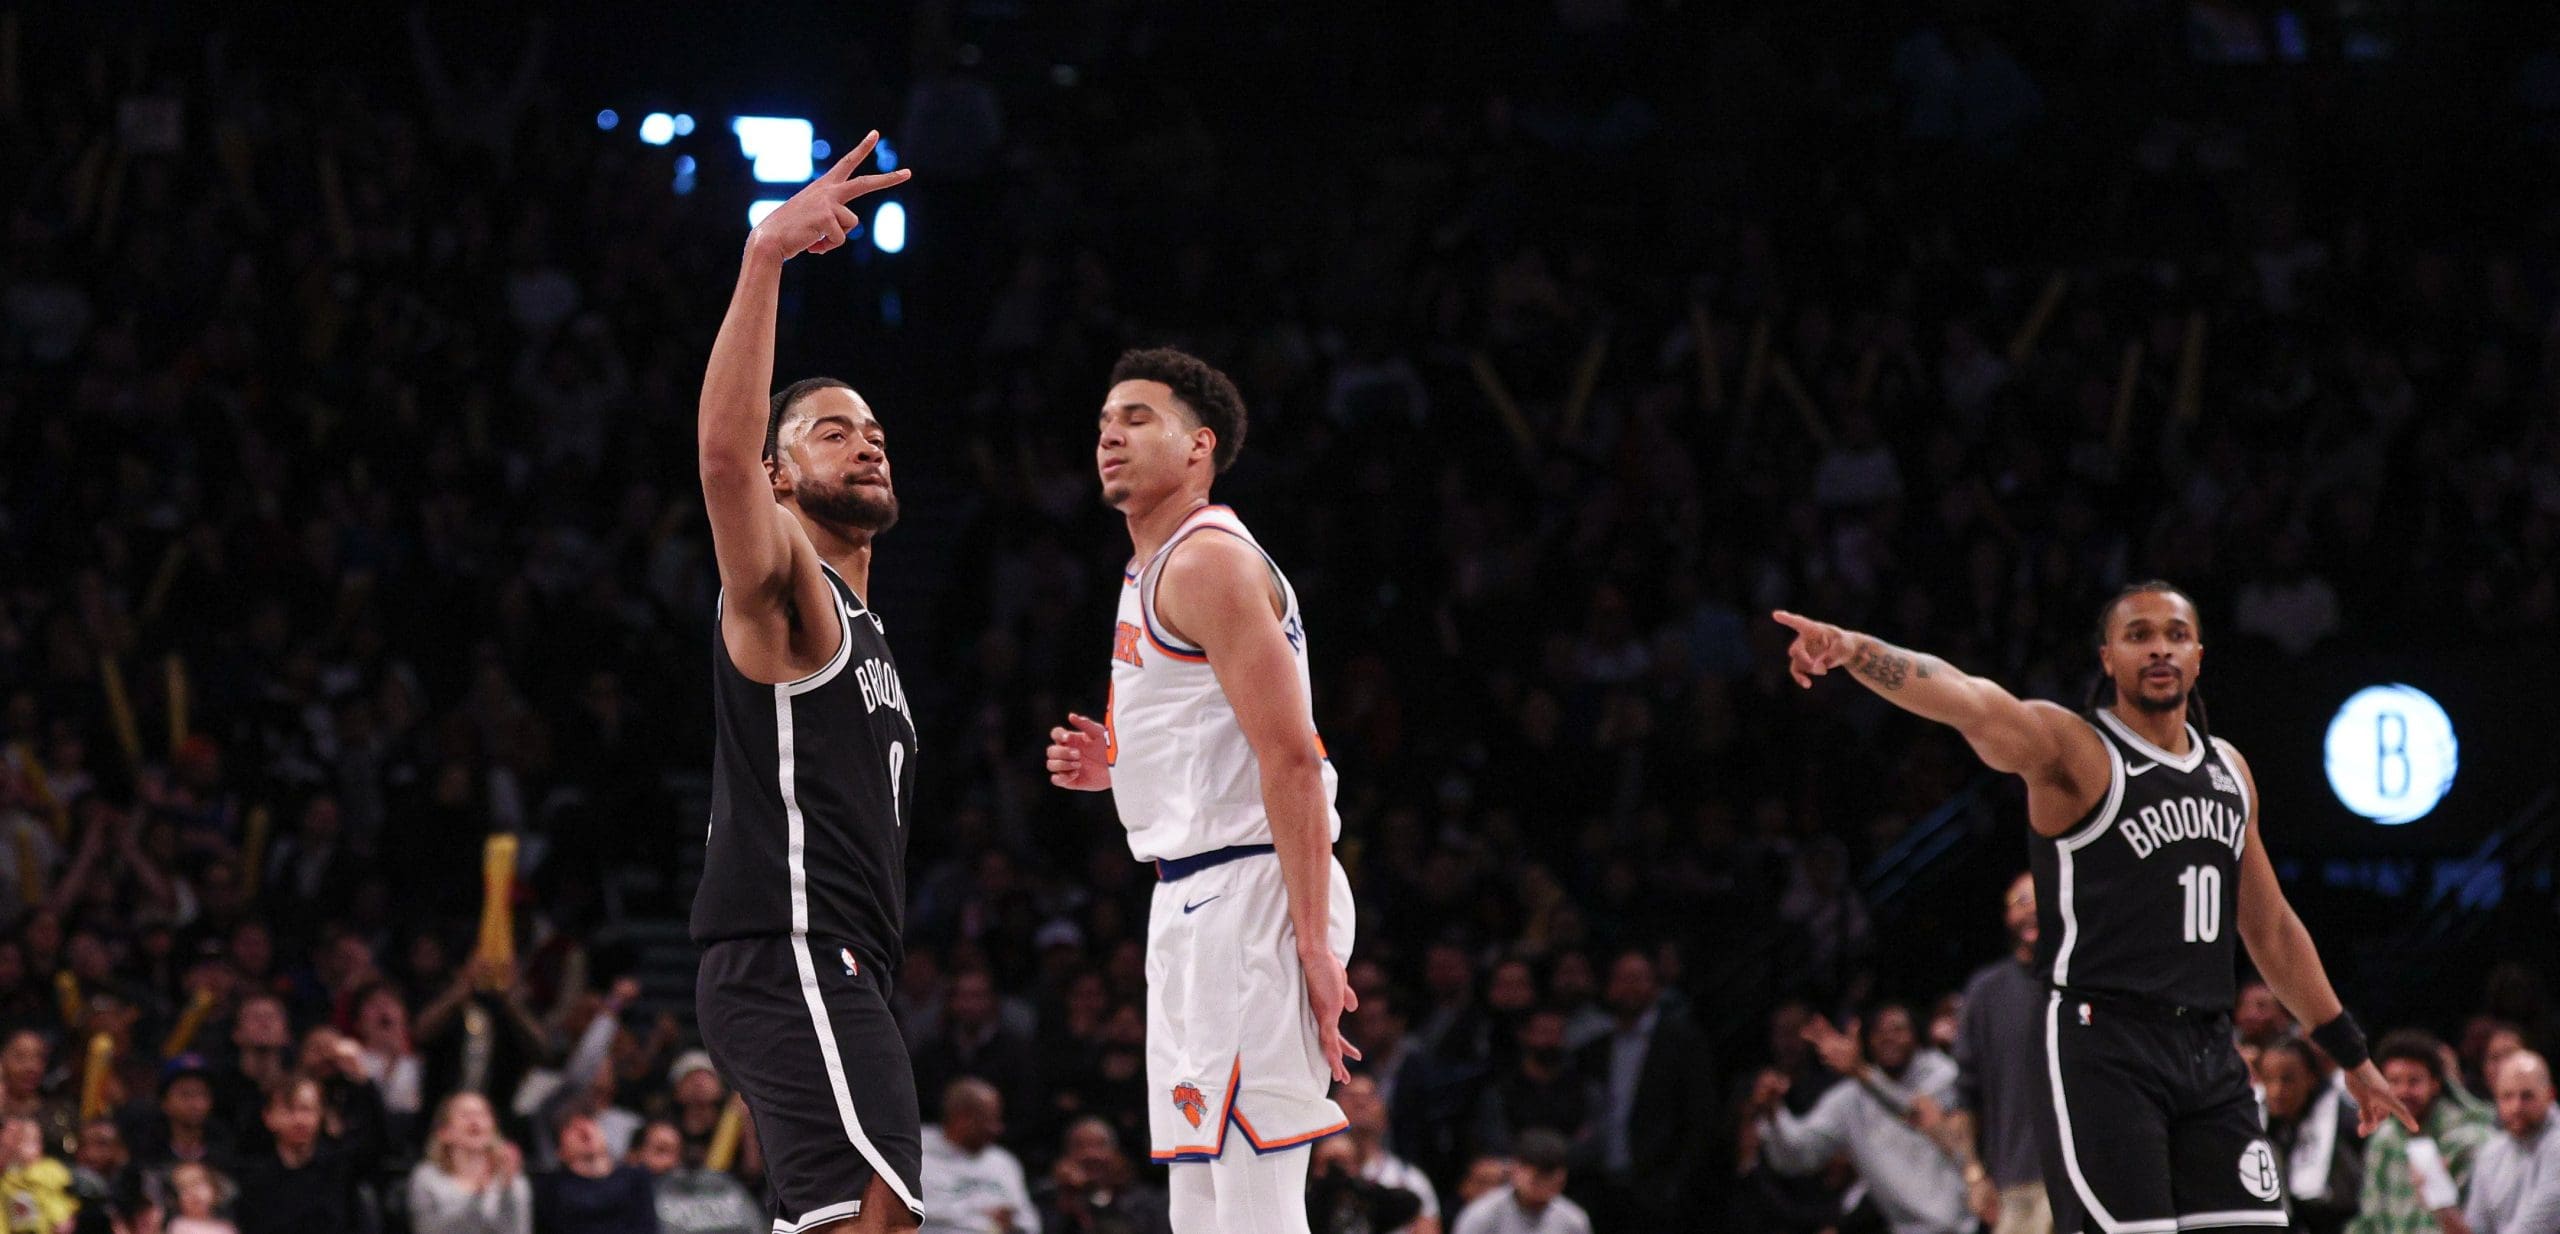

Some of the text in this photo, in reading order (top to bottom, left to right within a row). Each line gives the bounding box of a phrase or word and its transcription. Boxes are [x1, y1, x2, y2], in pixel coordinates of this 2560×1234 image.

[2377, 711, 2410, 797] B
[2178, 865, 2221, 943] 10
[2258, 1149, 2273, 1191] B
